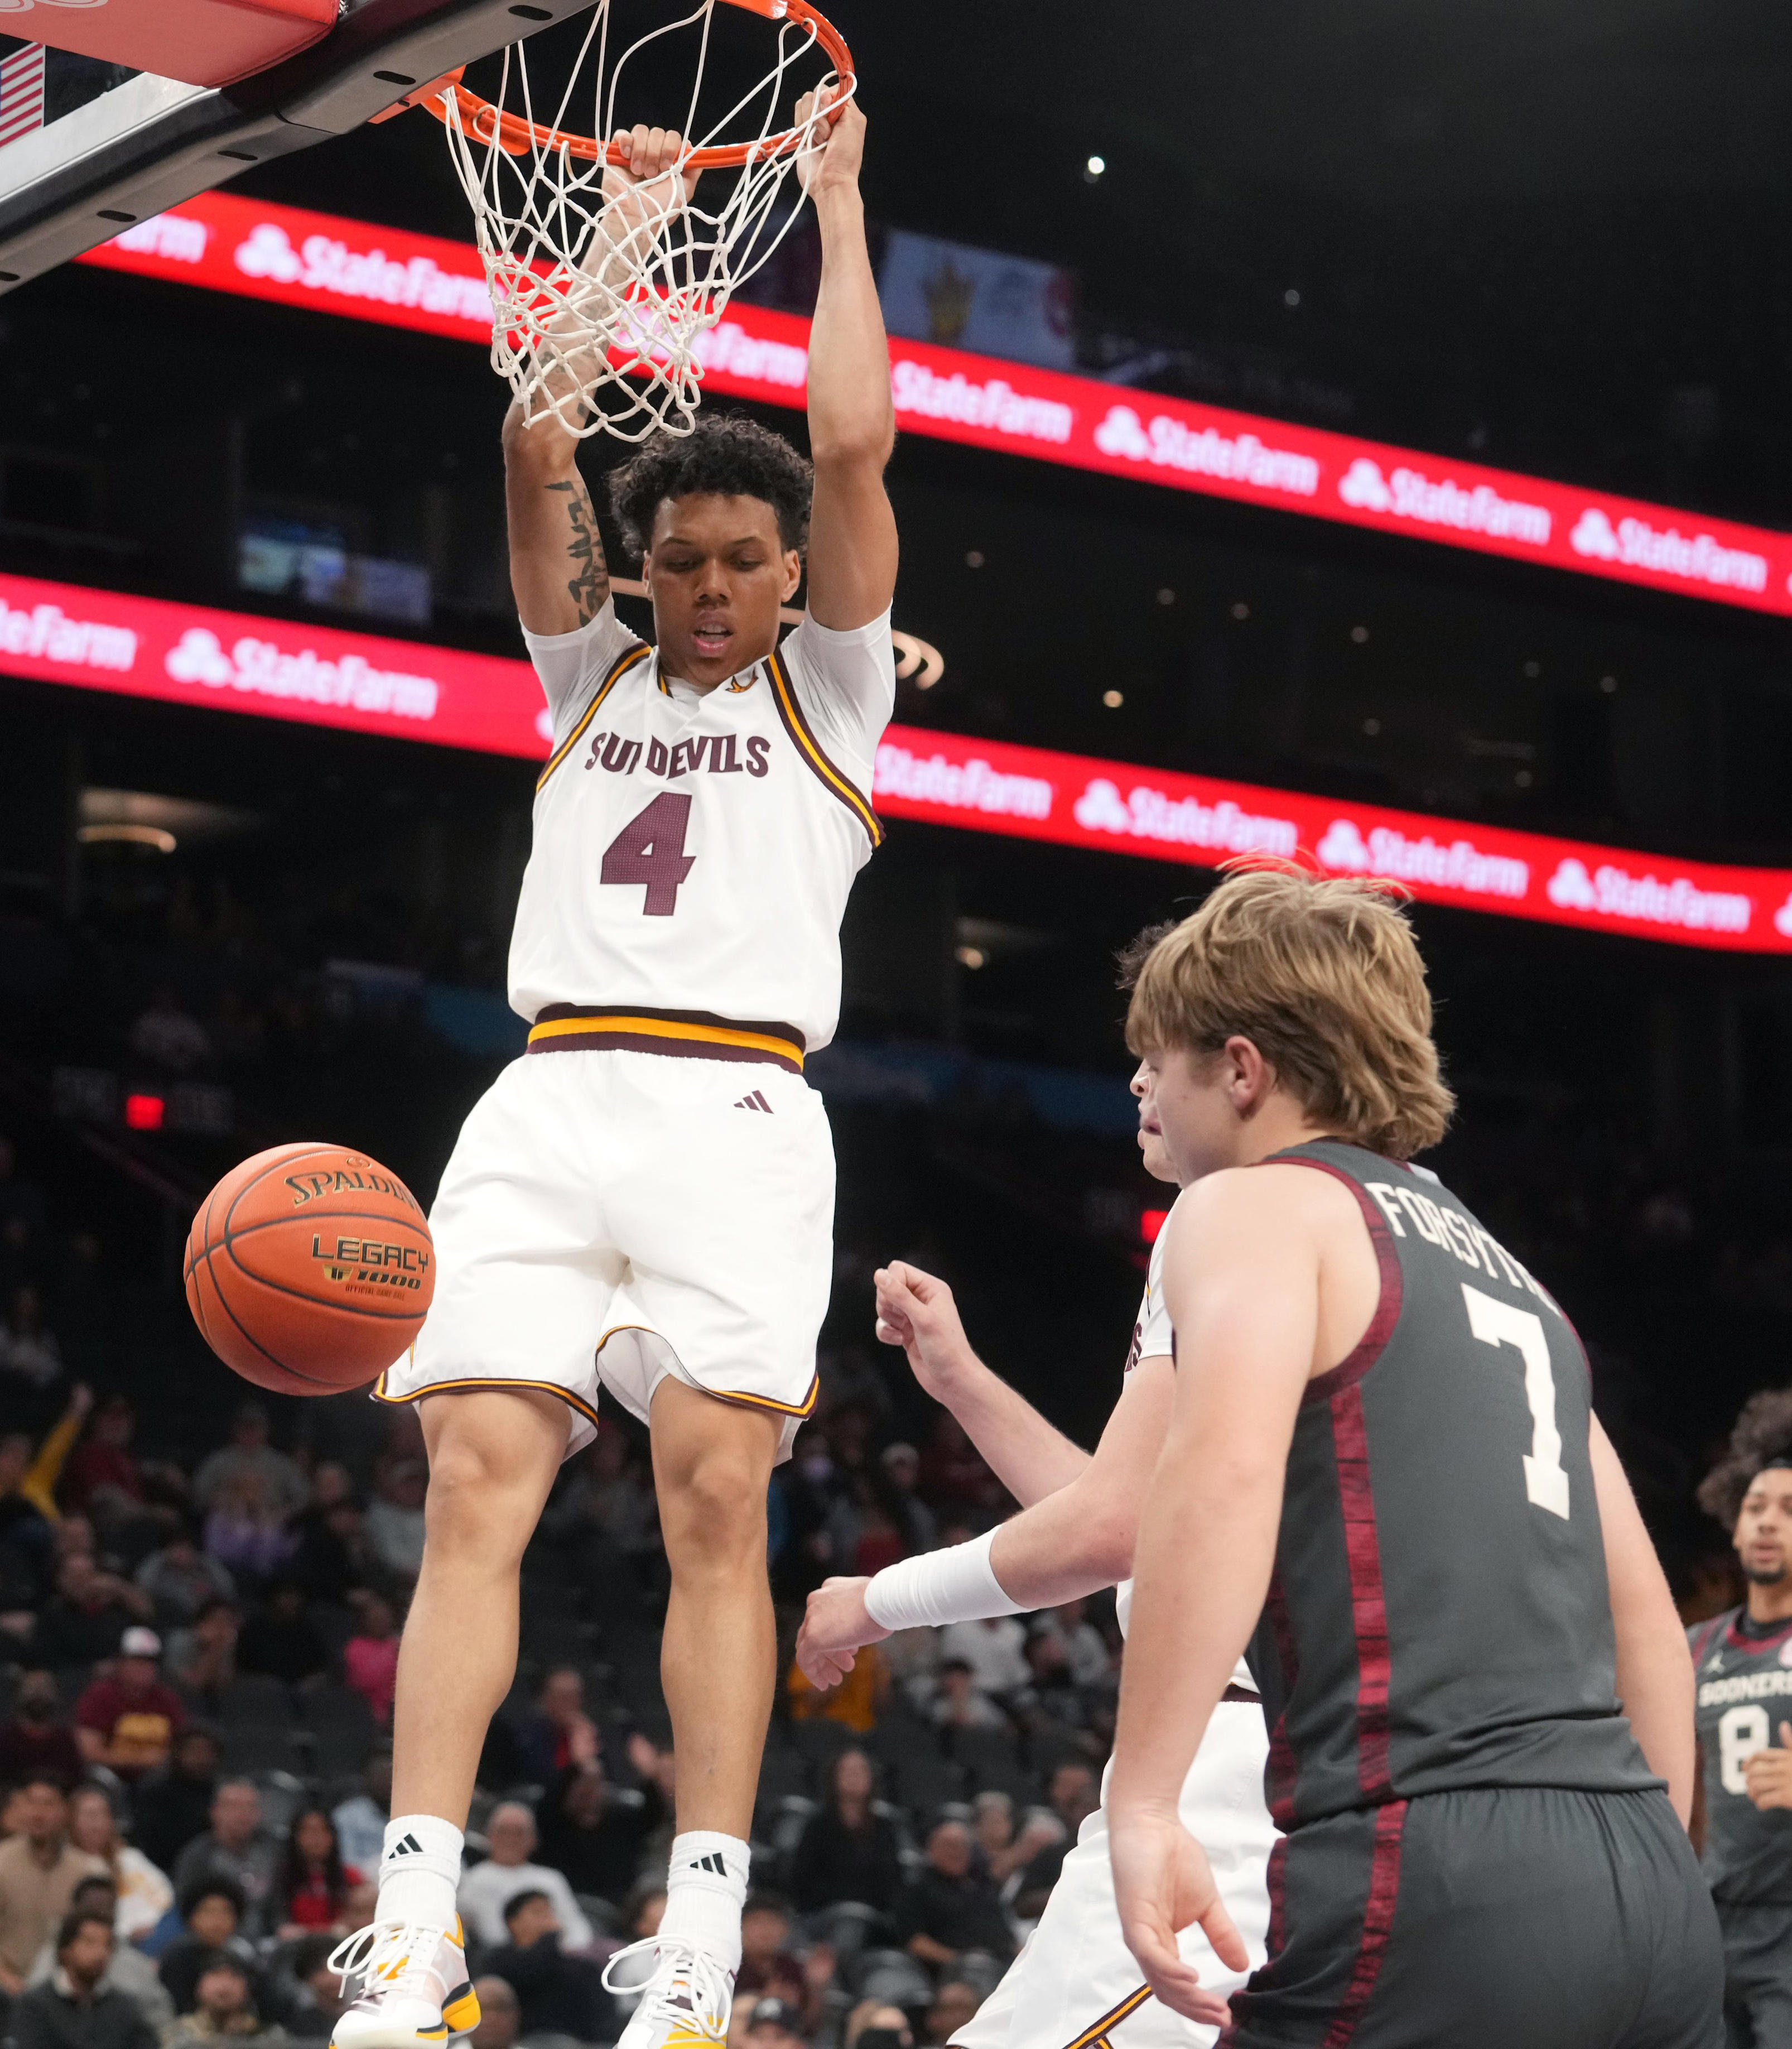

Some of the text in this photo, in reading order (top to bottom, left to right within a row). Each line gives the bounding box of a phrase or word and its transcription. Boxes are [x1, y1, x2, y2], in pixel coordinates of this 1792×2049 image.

[645, 734, 771, 780] DEVILS
[600, 791, 696, 916] 4
[312, 1233, 428, 1274] LEGACY
[1461, 1282, 1570, 1521] 7
[1699, 1670, 1792, 1708] SOONER
